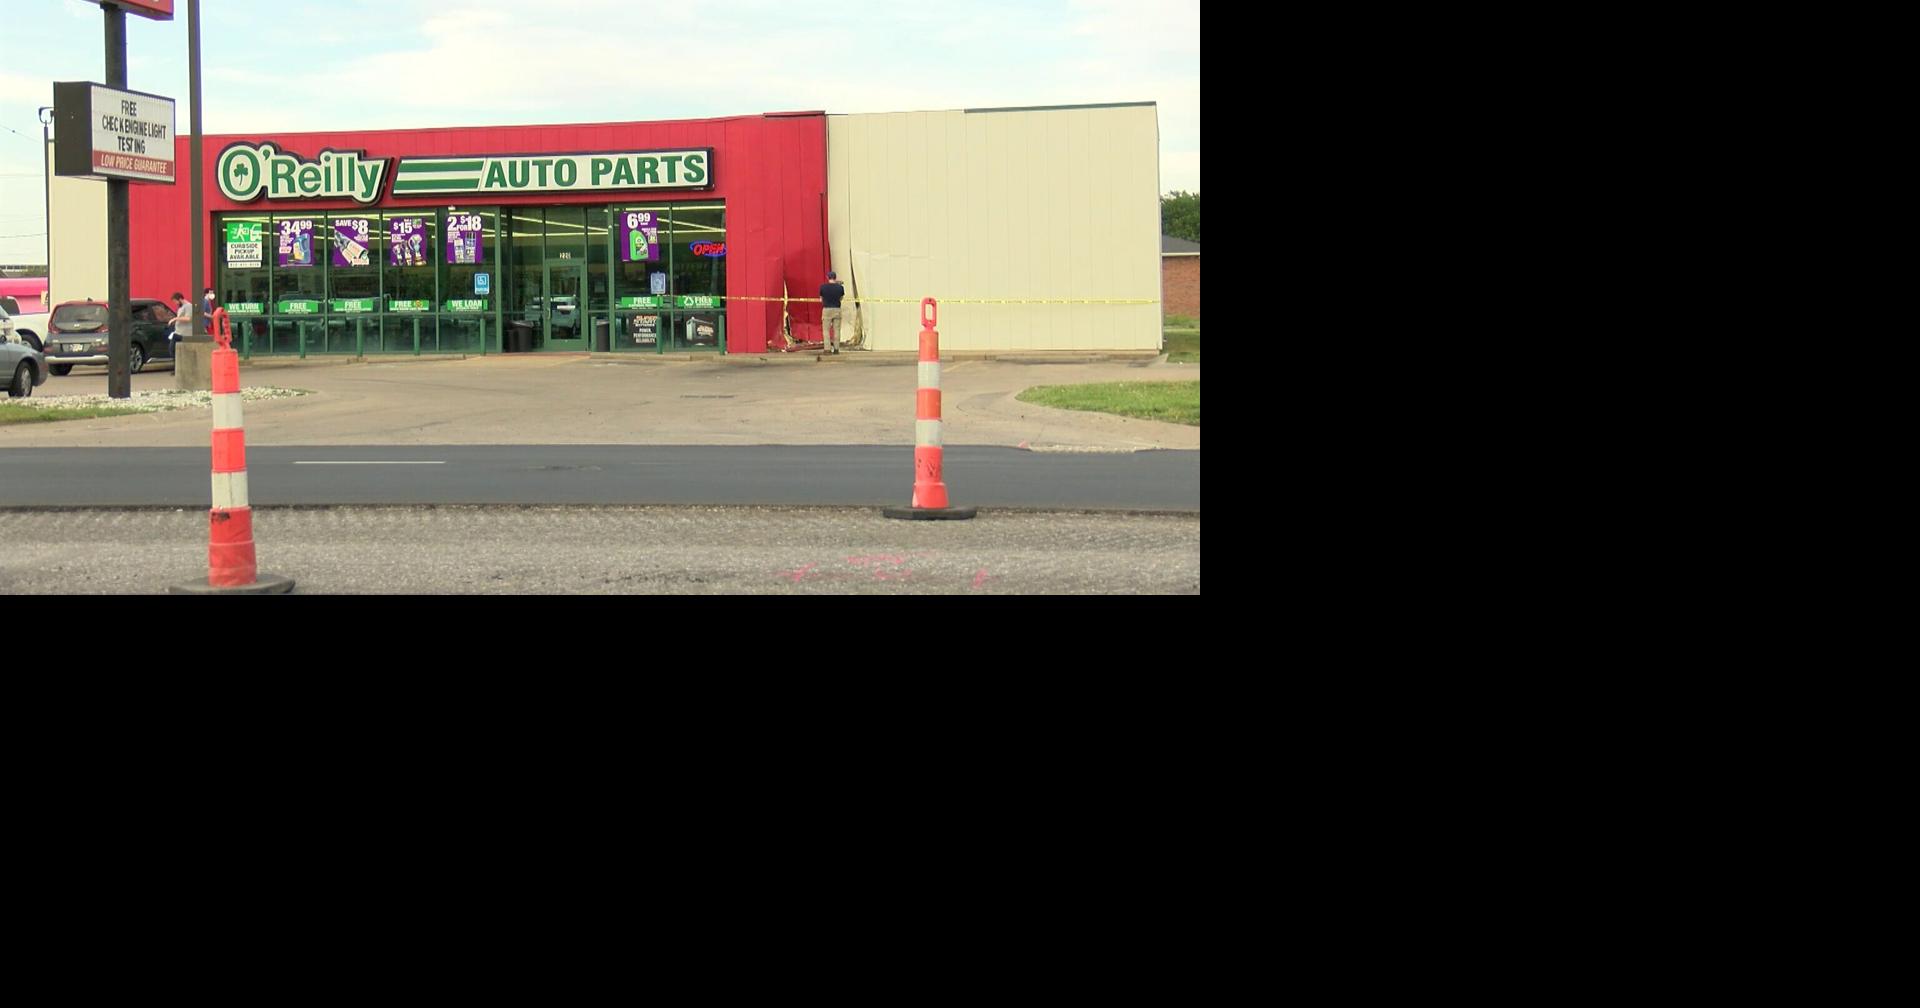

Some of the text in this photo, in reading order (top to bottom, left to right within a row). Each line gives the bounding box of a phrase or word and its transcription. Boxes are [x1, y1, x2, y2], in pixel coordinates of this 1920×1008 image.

[122, 100, 137, 116] FREE
[102, 114, 166, 139] CHECK ENGINE LIGHT
[101, 153, 168, 174] LOW PRICE GUARANTEE
[222, 149, 380, 199] O'Reilly
[484, 154, 705, 188] AUTO PARTS
[393, 221, 413, 234] $15
[693, 243, 725, 256] OPEN
[290, 302, 307, 310] FREE
[345, 300, 361, 309] FREE
[395, 300, 412, 309] FREE
[633, 297, 651, 305] FREE
